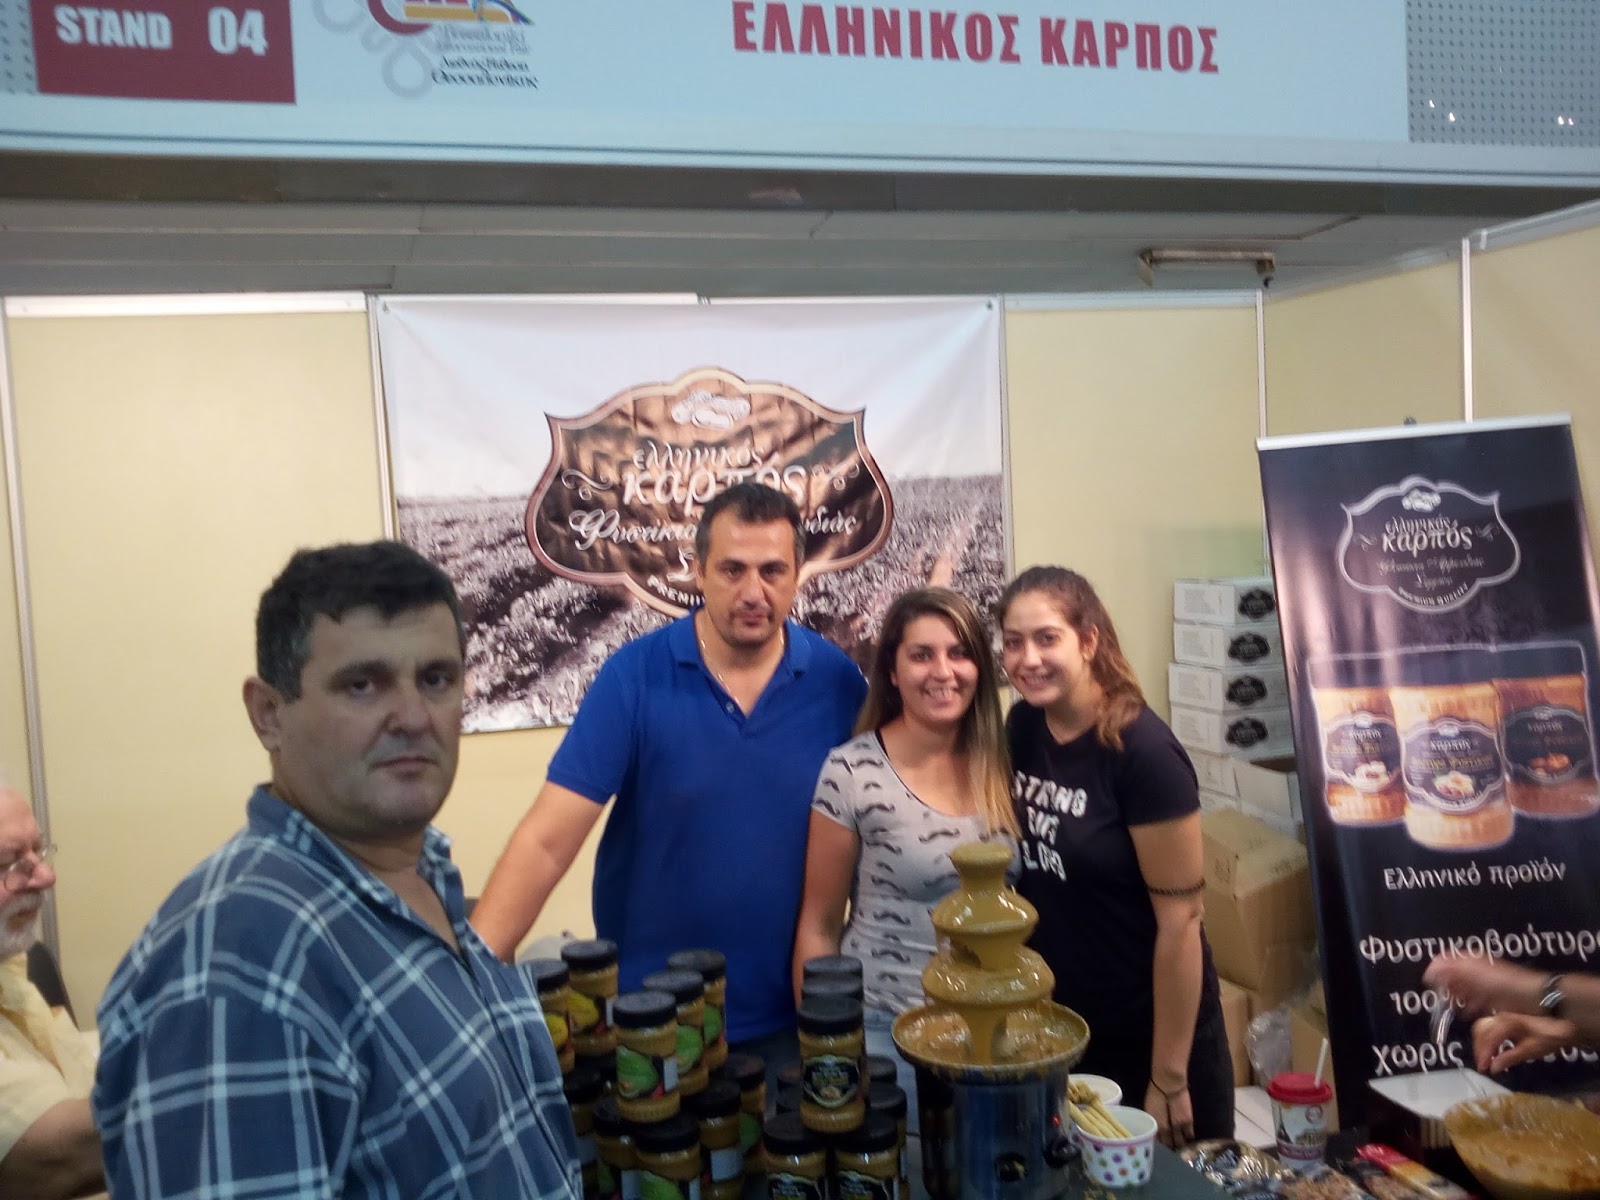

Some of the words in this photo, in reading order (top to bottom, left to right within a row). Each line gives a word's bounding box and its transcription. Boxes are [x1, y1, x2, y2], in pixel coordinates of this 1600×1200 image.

[54, 8, 174, 50] STAND
[207, 10, 268, 56] 04
[732, 1, 1021, 63] ΕΛΛΗΝΙΚΟΣ
[1039, 17, 1219, 73] ΚΑΡΠΟΣ
[1383, 861, 1482, 891] Ελληνικό
[1488, 857, 1567, 889] προϊόν
[1359, 923, 1600, 966] Φυστικοβούτυρ
